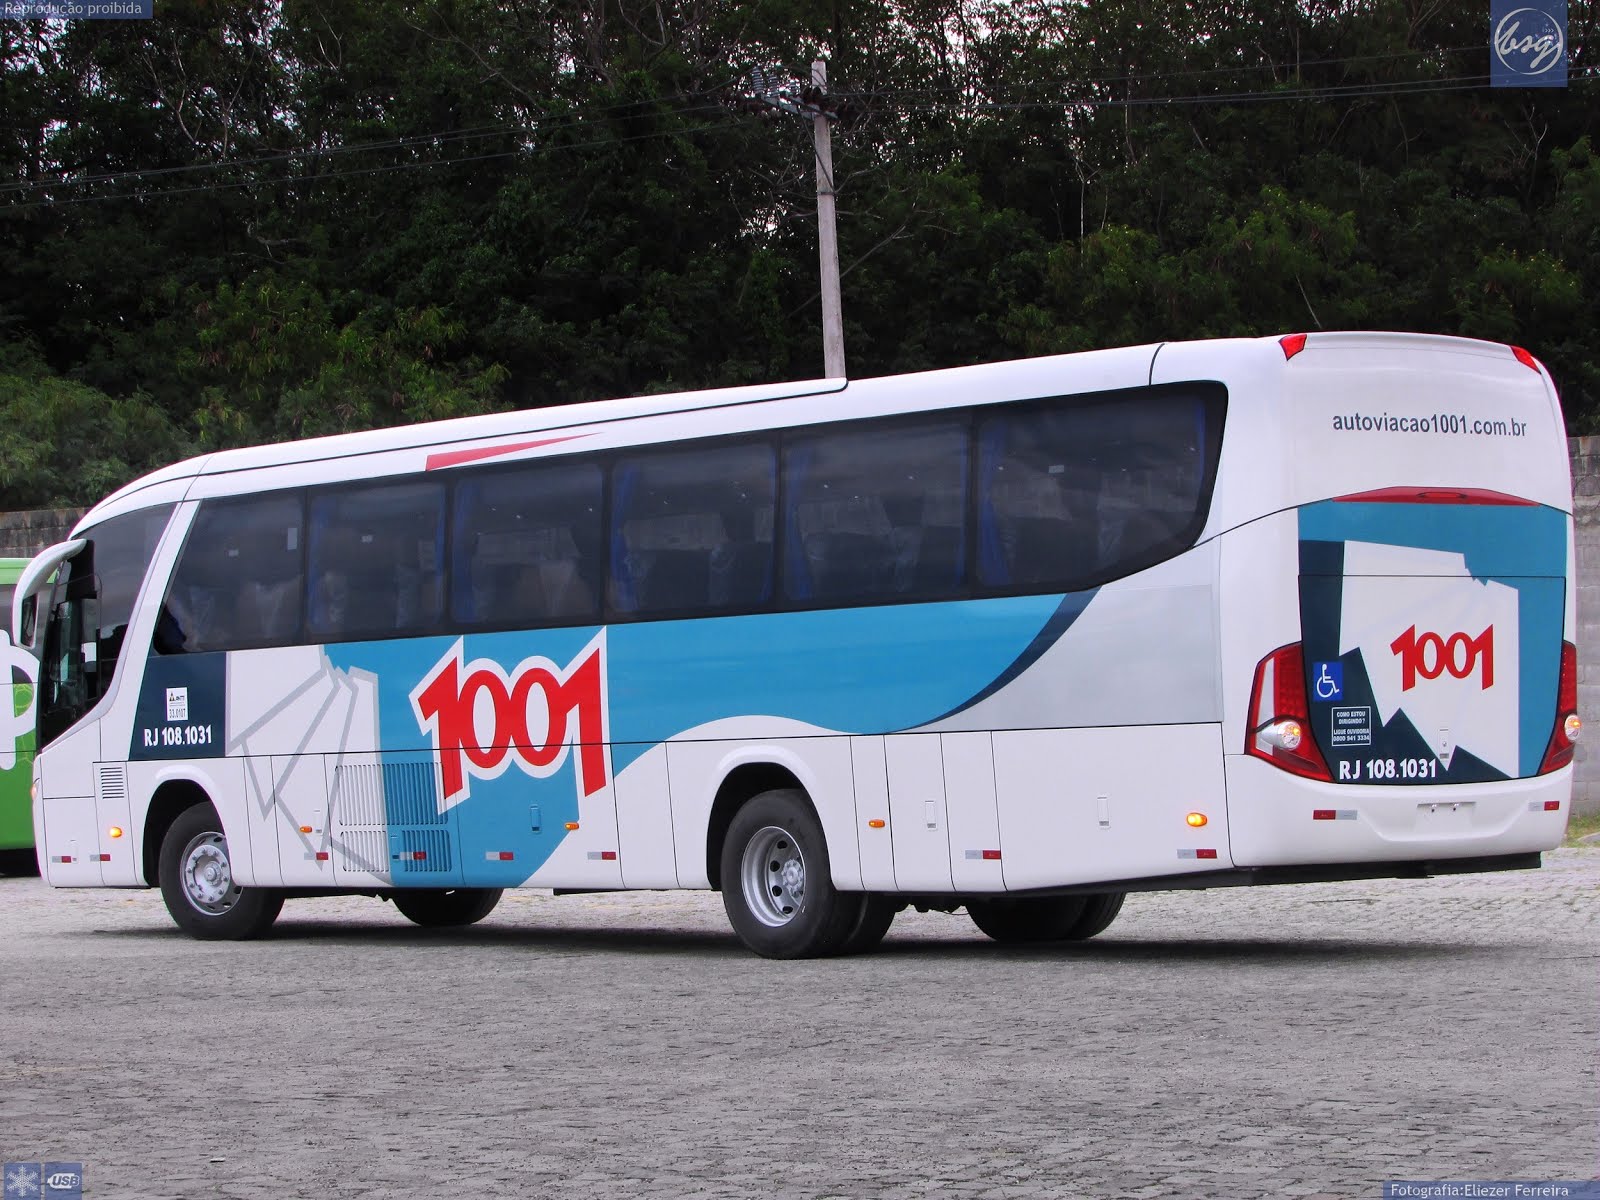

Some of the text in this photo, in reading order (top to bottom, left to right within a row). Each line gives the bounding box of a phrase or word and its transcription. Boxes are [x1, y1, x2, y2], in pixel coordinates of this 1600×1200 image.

[1332, 412, 1527, 437] autoviacao1001.com.br
[1389, 623, 1494, 692] 1001
[144, 724, 212, 747] RJ 108.1031
[416, 646, 608, 800] 1001
[1339, 758, 1437, 780] RJ 108.1031
